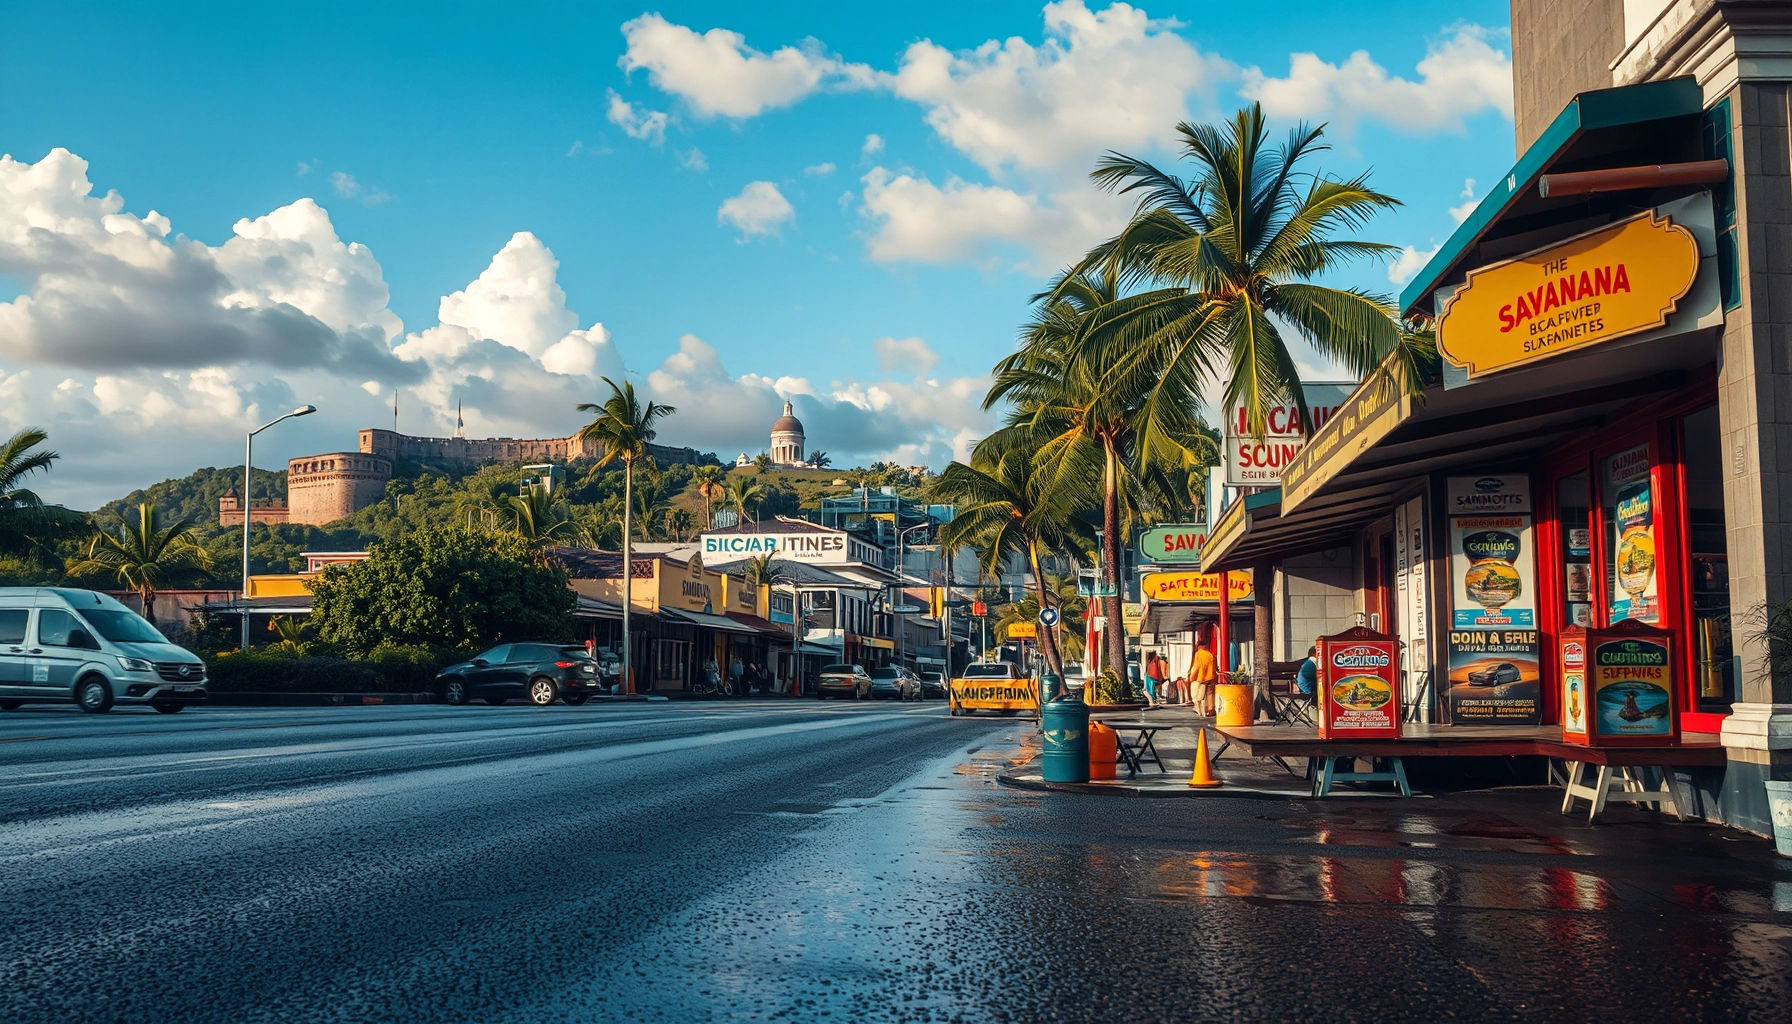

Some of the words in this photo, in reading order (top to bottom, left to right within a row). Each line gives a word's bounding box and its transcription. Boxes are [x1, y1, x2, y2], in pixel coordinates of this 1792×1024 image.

[1542, 257, 1568, 276] THE
[1498, 263, 1631, 333] SAVANANA
[1238, 444, 1303, 468] SCUN
